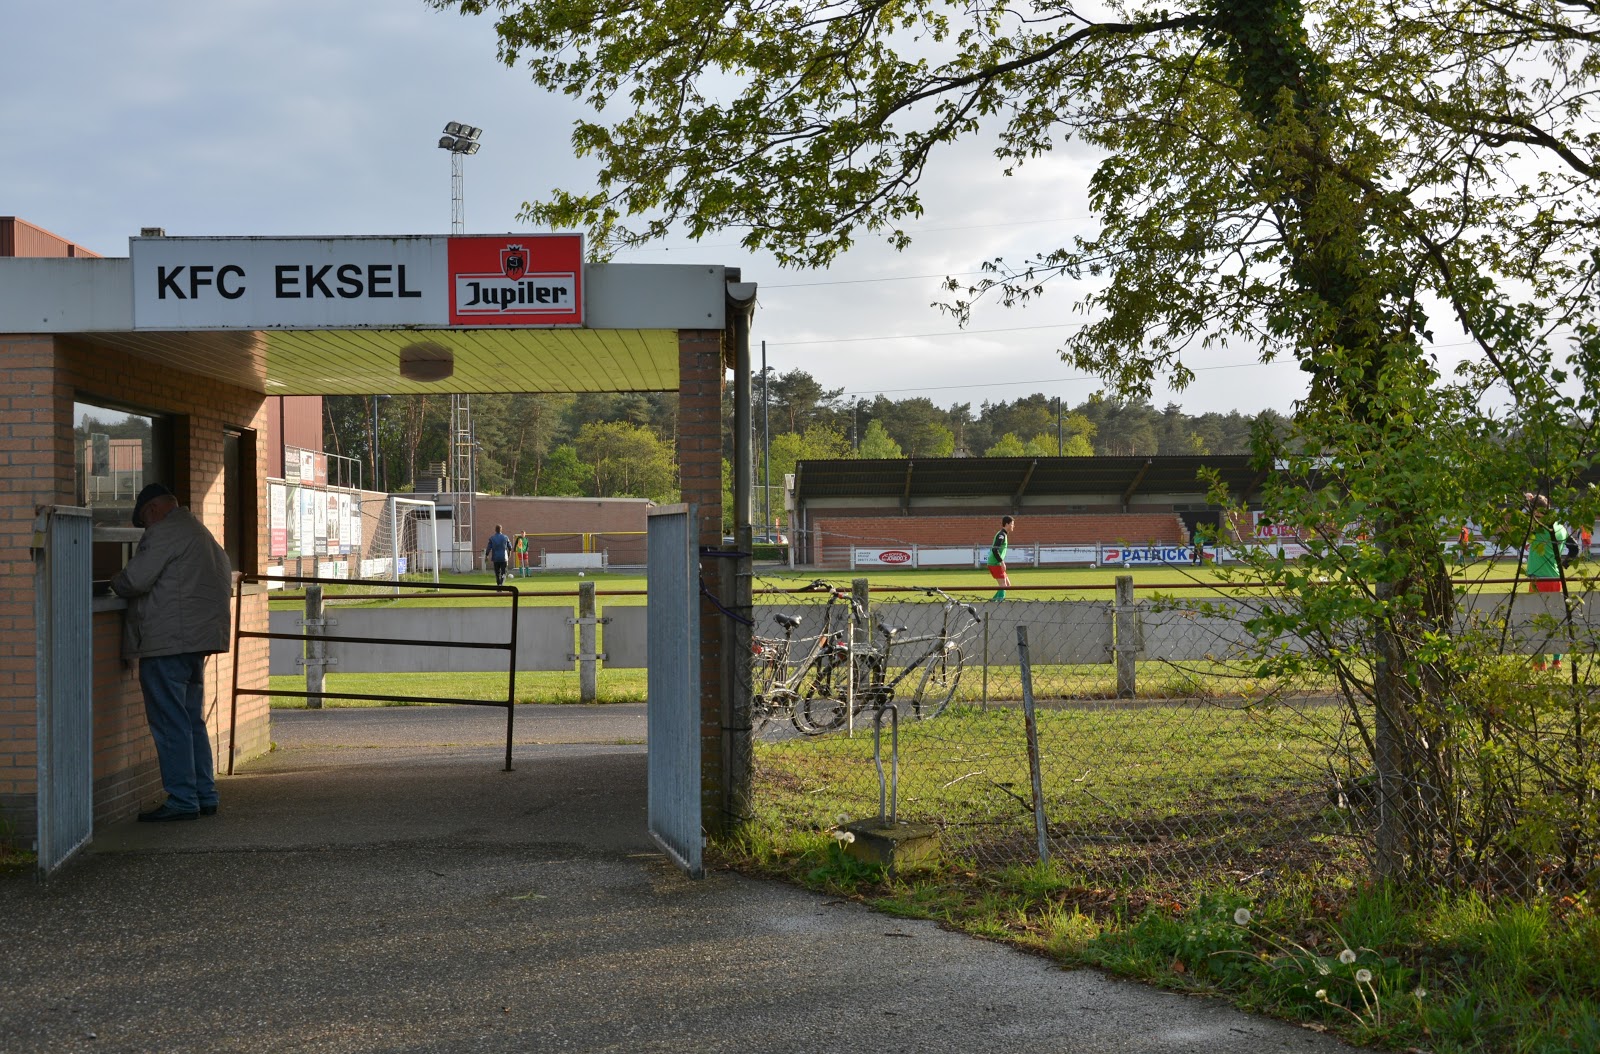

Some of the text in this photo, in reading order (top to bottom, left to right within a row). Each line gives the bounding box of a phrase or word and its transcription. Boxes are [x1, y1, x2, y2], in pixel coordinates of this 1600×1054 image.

[157, 263, 422, 300] KFC EKSEL
[463, 281, 568, 311] Jupiler
[1122, 548, 1188, 562] PATRICK
